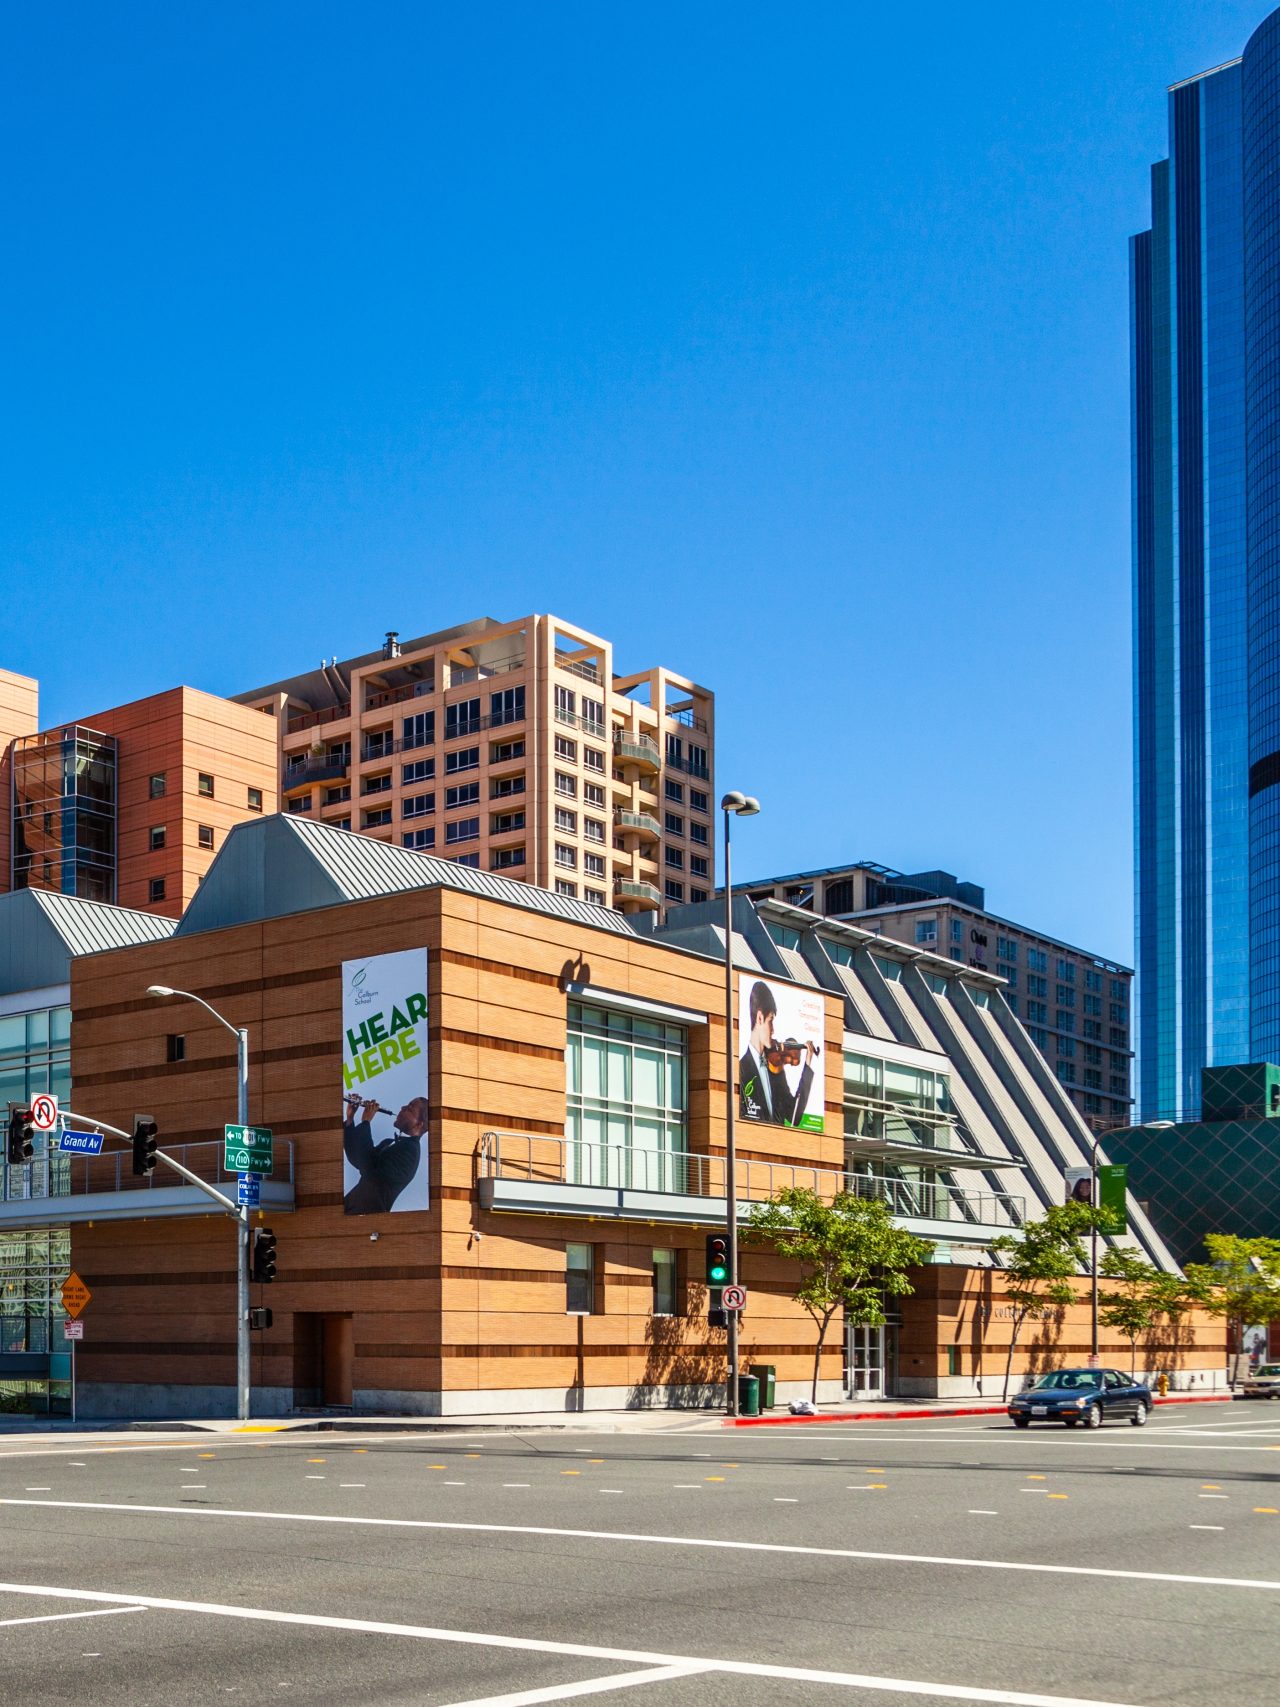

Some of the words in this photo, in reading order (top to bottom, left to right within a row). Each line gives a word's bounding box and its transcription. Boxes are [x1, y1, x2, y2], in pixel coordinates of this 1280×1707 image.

[354, 997, 372, 1006] School
[346, 993, 428, 1056] HEAR
[343, 1027, 421, 1090] HERE
[64, 1135, 87, 1148] Grand
[88, 1138, 99, 1149] Av
[257, 1136, 270, 1145] Fwy
[238, 1156, 247, 1164] 110
[250, 1157, 263, 1167] Fwy
